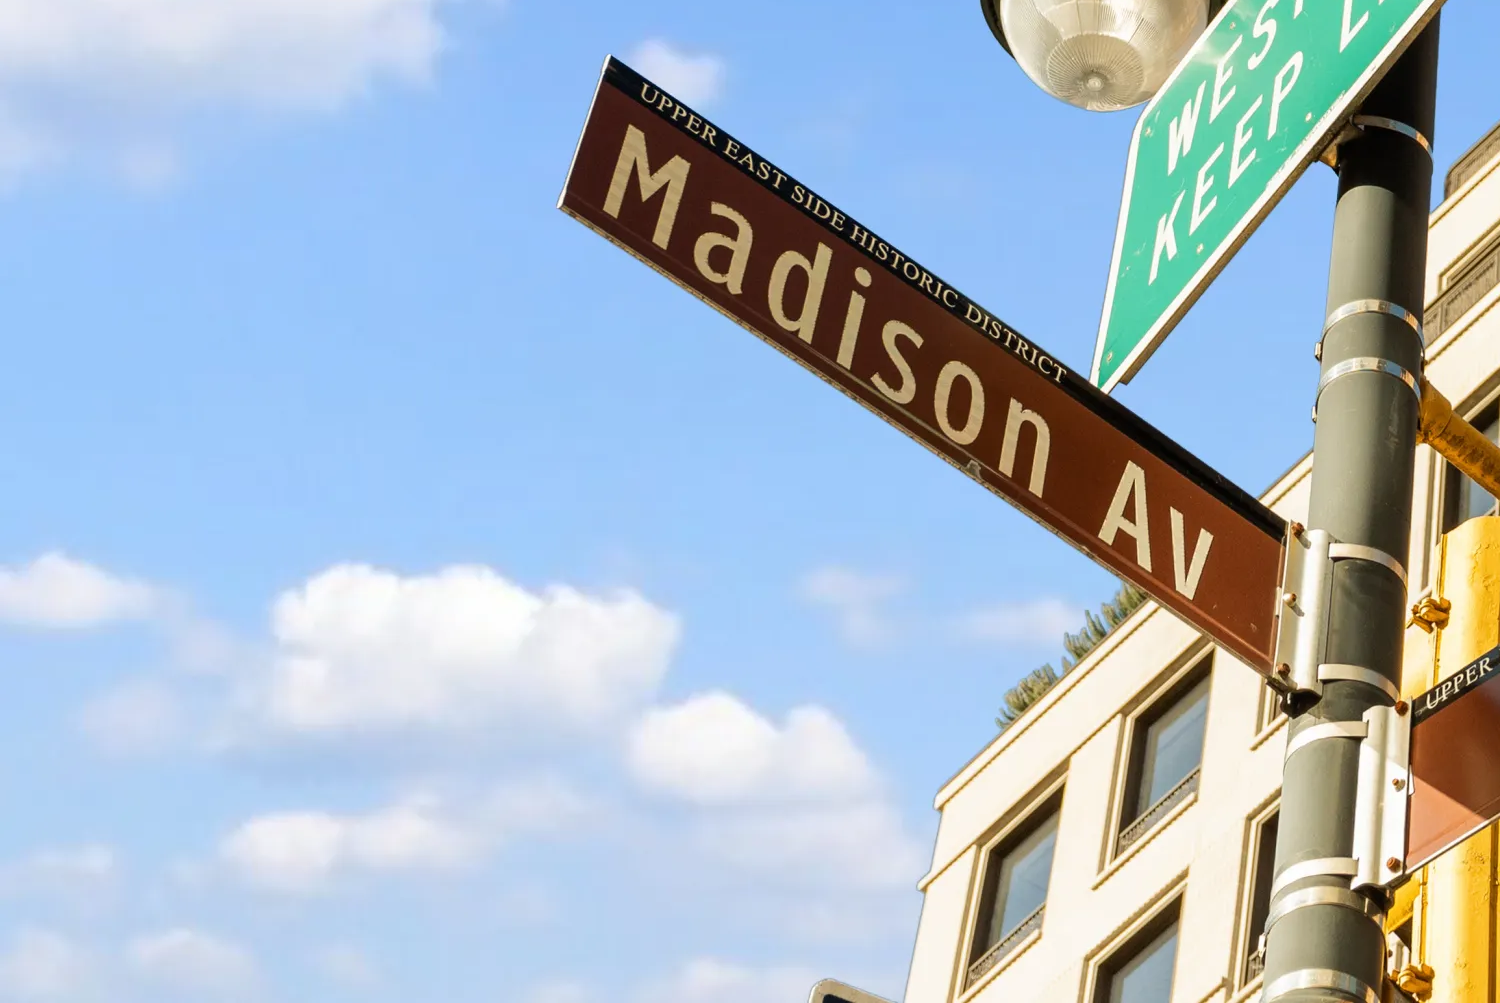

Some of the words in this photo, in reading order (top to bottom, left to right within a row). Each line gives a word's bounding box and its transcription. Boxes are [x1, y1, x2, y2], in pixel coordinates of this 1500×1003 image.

[640, 82, 718, 147] UPPER
[722, 143, 788, 191] EAST
[791, 185, 845, 232] SIDE
[850, 224, 959, 309] HISTORIC
[963, 304, 1068, 384] DISTRICT
[1149, 51, 1303, 285] KEEP
[602, 124, 1051, 500] Madison
[1098, 460, 1214, 601] Av
[1425, 658, 1492, 710] UPPER
